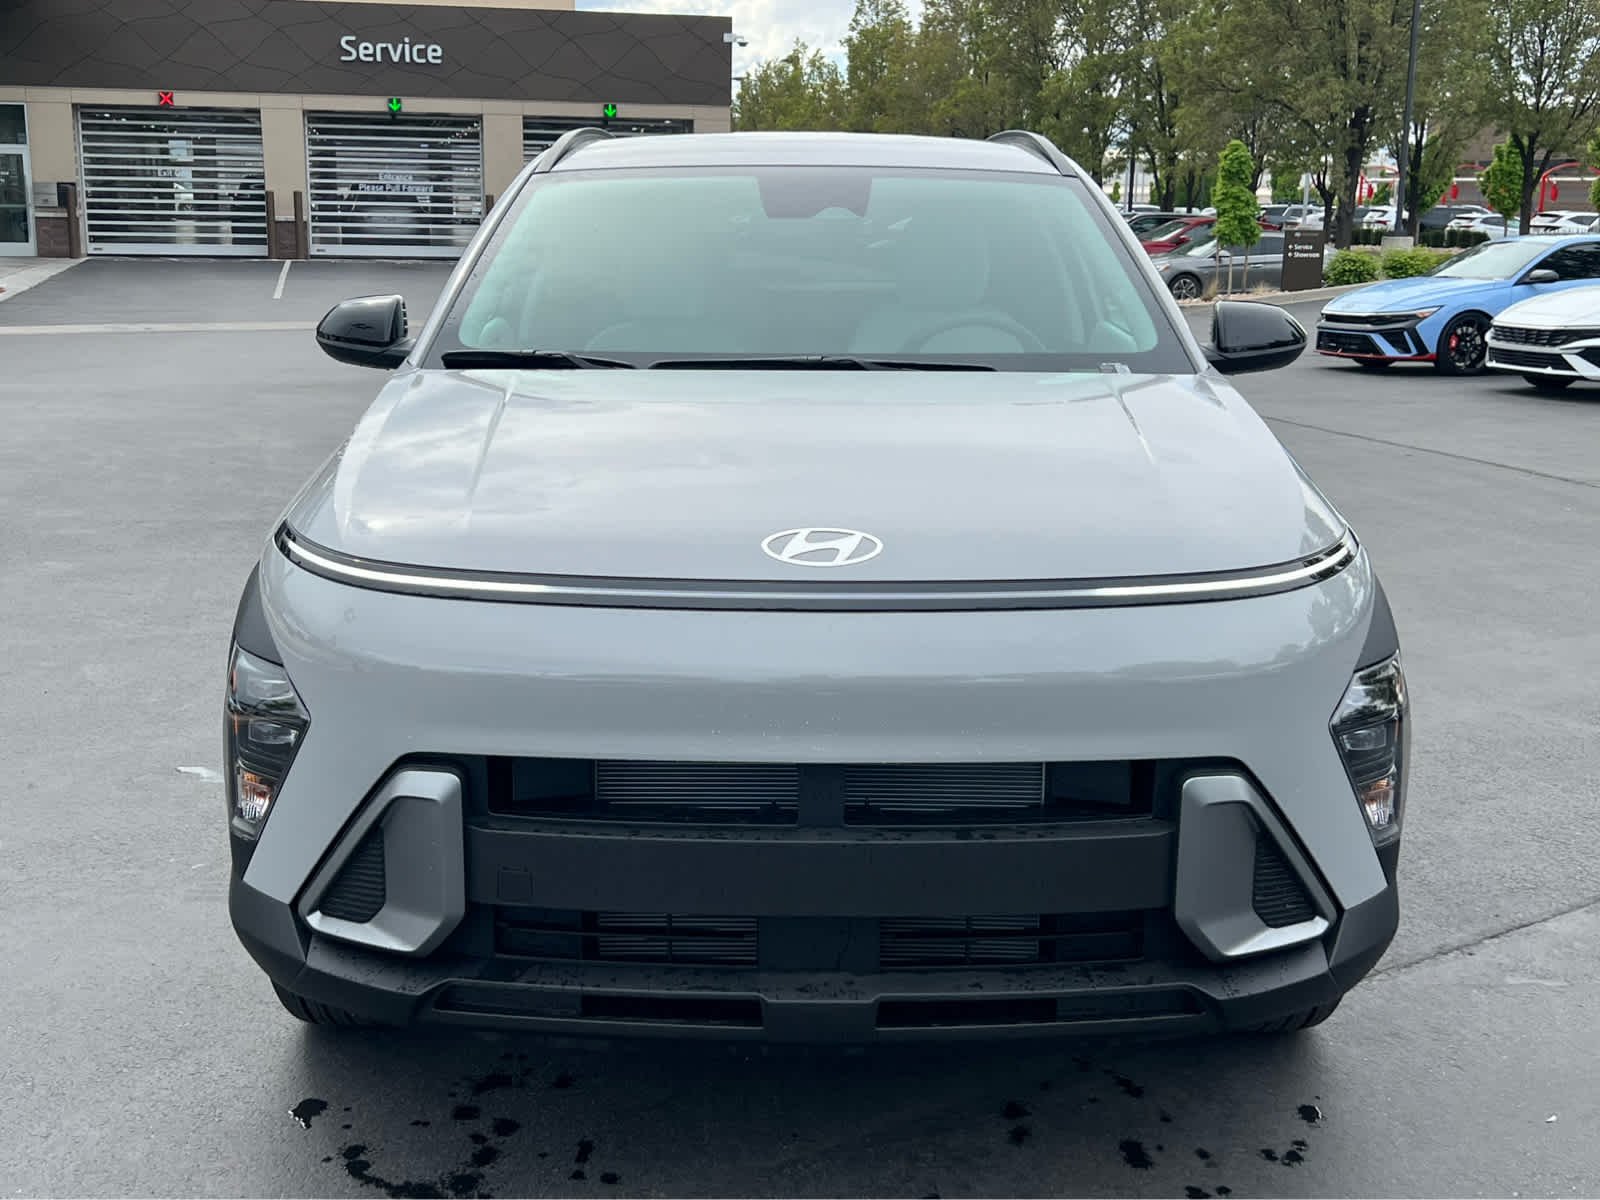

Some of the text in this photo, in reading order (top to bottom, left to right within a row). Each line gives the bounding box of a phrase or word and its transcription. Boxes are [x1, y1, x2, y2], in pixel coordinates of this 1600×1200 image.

[340, 35, 443, 64] Service
[378, 172, 413, 181] Entrance
[359, 183, 433, 193] Please Pull Forward
